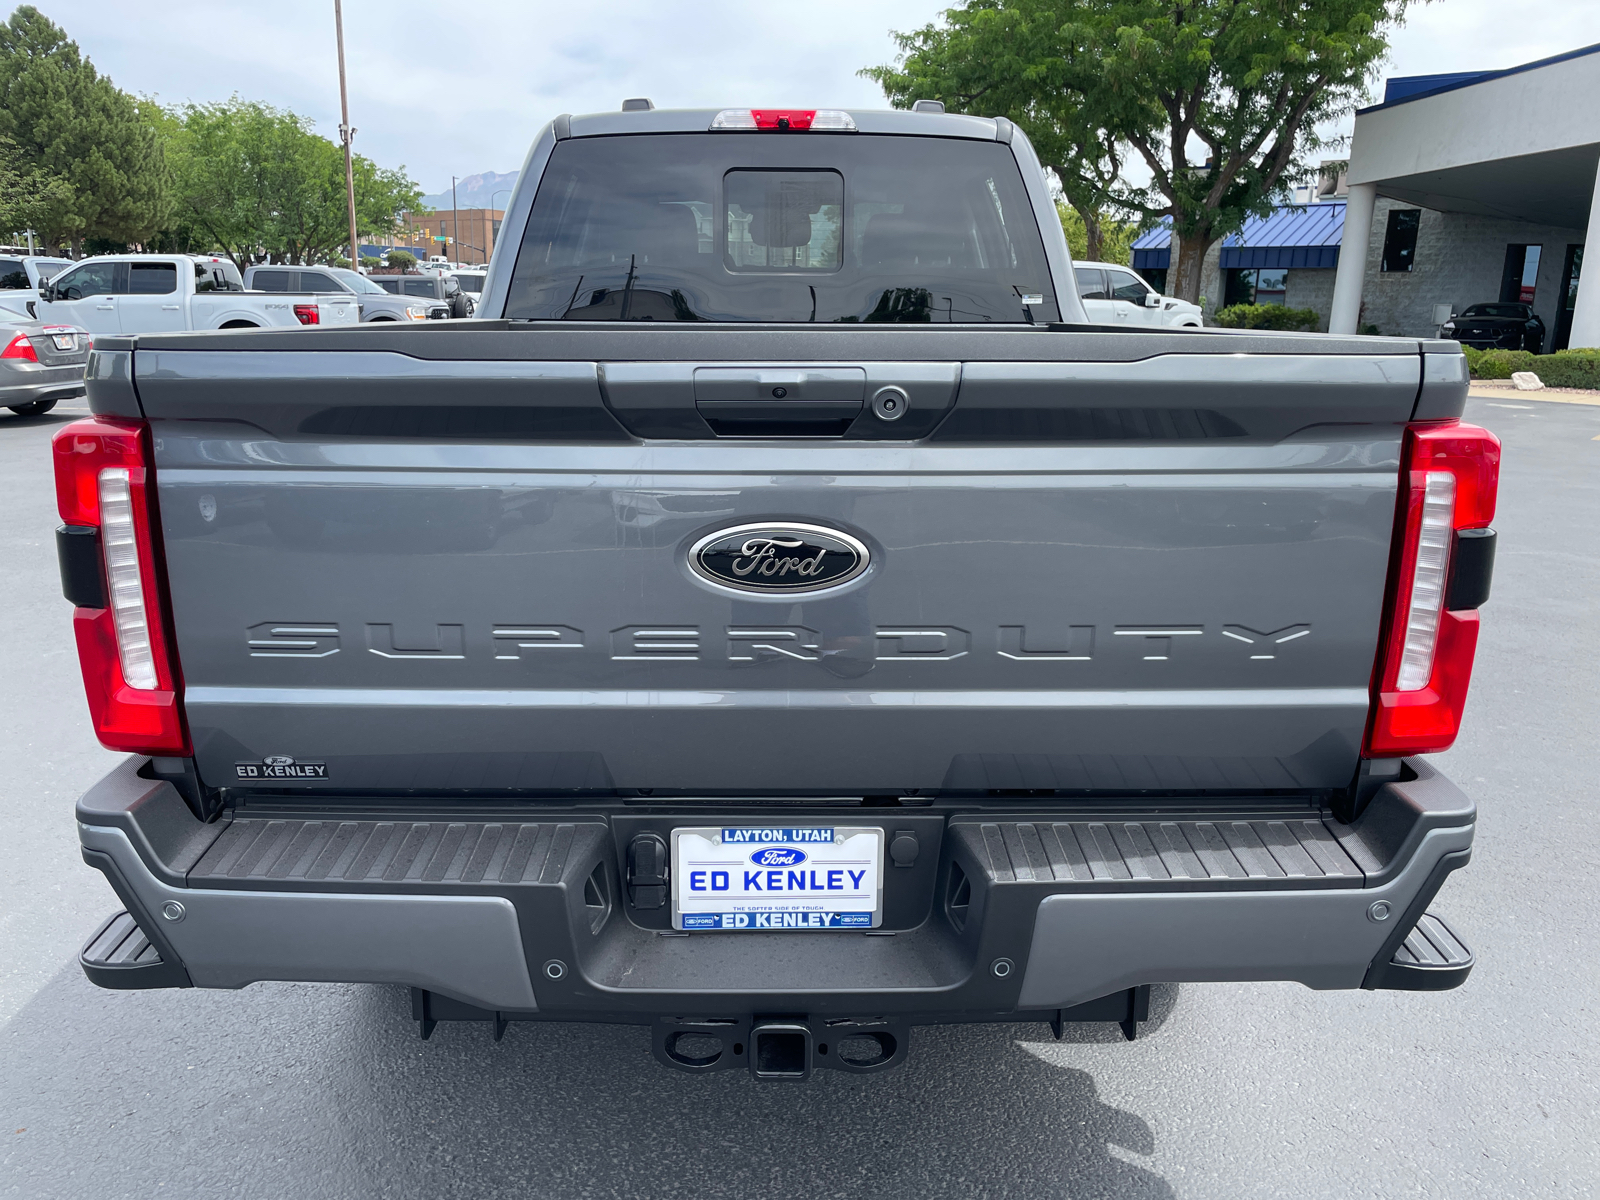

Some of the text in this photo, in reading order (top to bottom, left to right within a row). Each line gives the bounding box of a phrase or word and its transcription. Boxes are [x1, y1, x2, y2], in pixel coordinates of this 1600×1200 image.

[732, 538, 827, 577] Ford
[246, 621, 1312, 662] SUPER DUTY
[236, 766, 325, 777] ED KENLEY
[724, 829, 831, 843] LAYTON, UTAH
[760, 850, 796, 865] Ford
[690, 870, 867, 891] ED KENLEY
[722, 912, 835, 928] ED KENLEY
